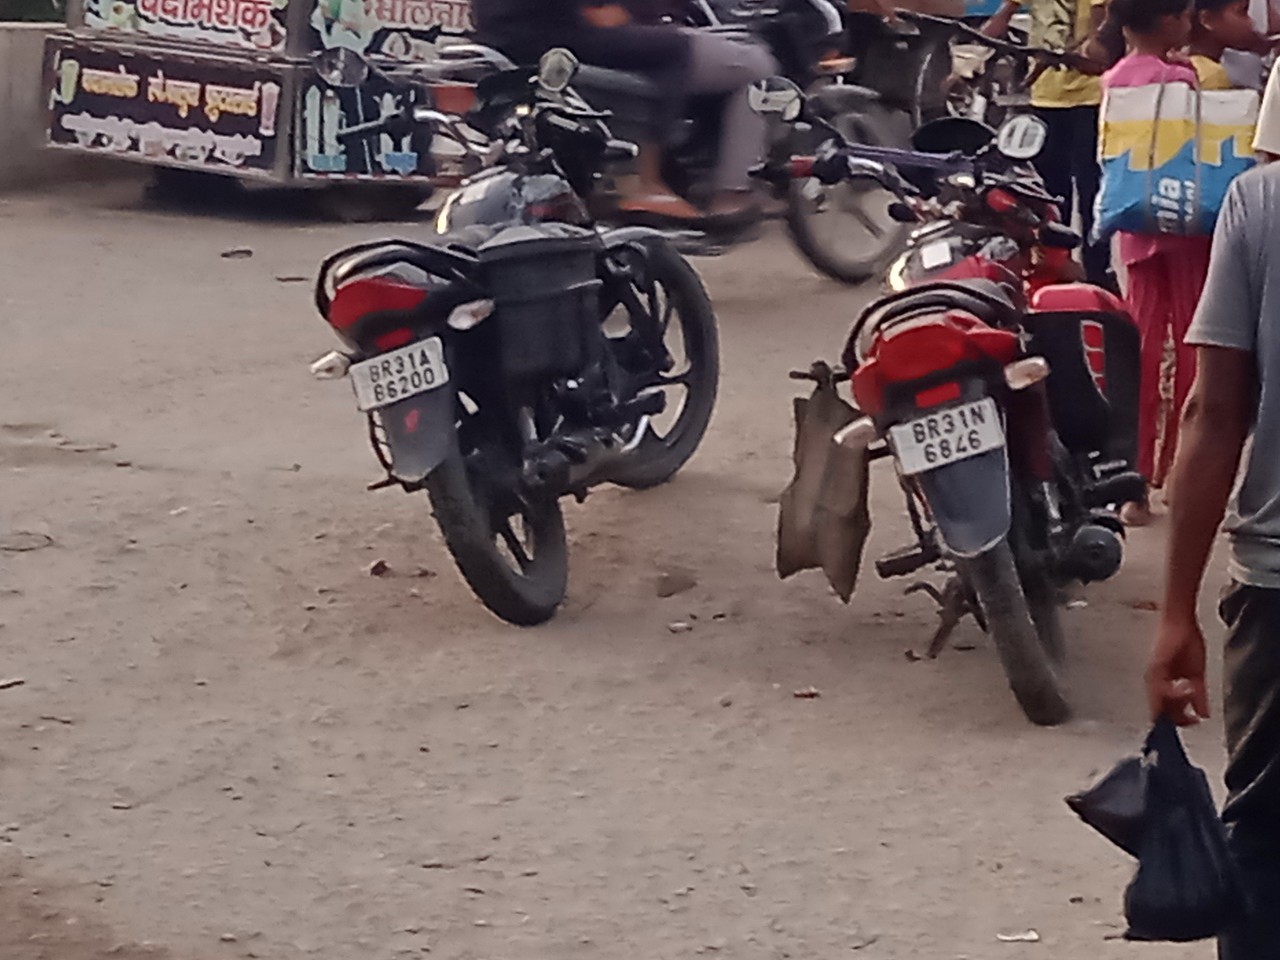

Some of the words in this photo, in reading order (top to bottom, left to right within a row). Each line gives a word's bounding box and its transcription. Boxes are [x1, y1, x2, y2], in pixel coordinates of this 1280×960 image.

[368, 348, 431, 384] BR31A
[911, 405, 986, 444] BR31N
[923, 428, 982, 464] 6846
